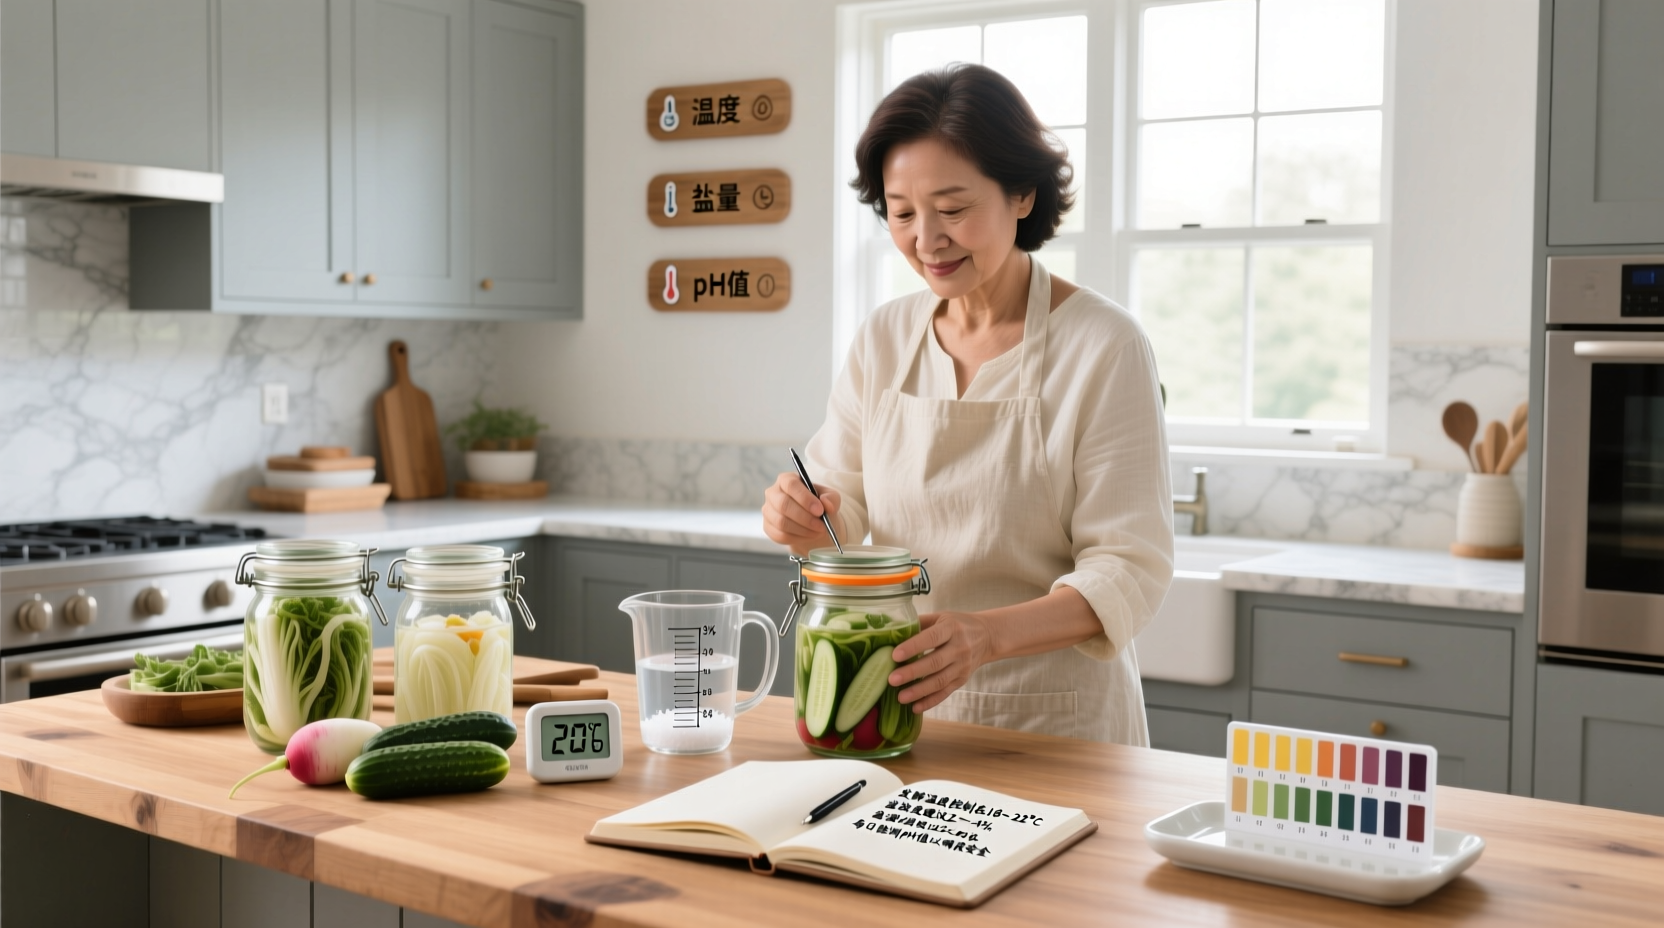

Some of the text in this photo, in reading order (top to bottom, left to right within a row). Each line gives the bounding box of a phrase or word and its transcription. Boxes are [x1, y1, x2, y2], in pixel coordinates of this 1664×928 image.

[691, 94, 741, 126] 温度
[691, 183, 741, 214] 盐量
[693, 269, 750, 303] pH值
